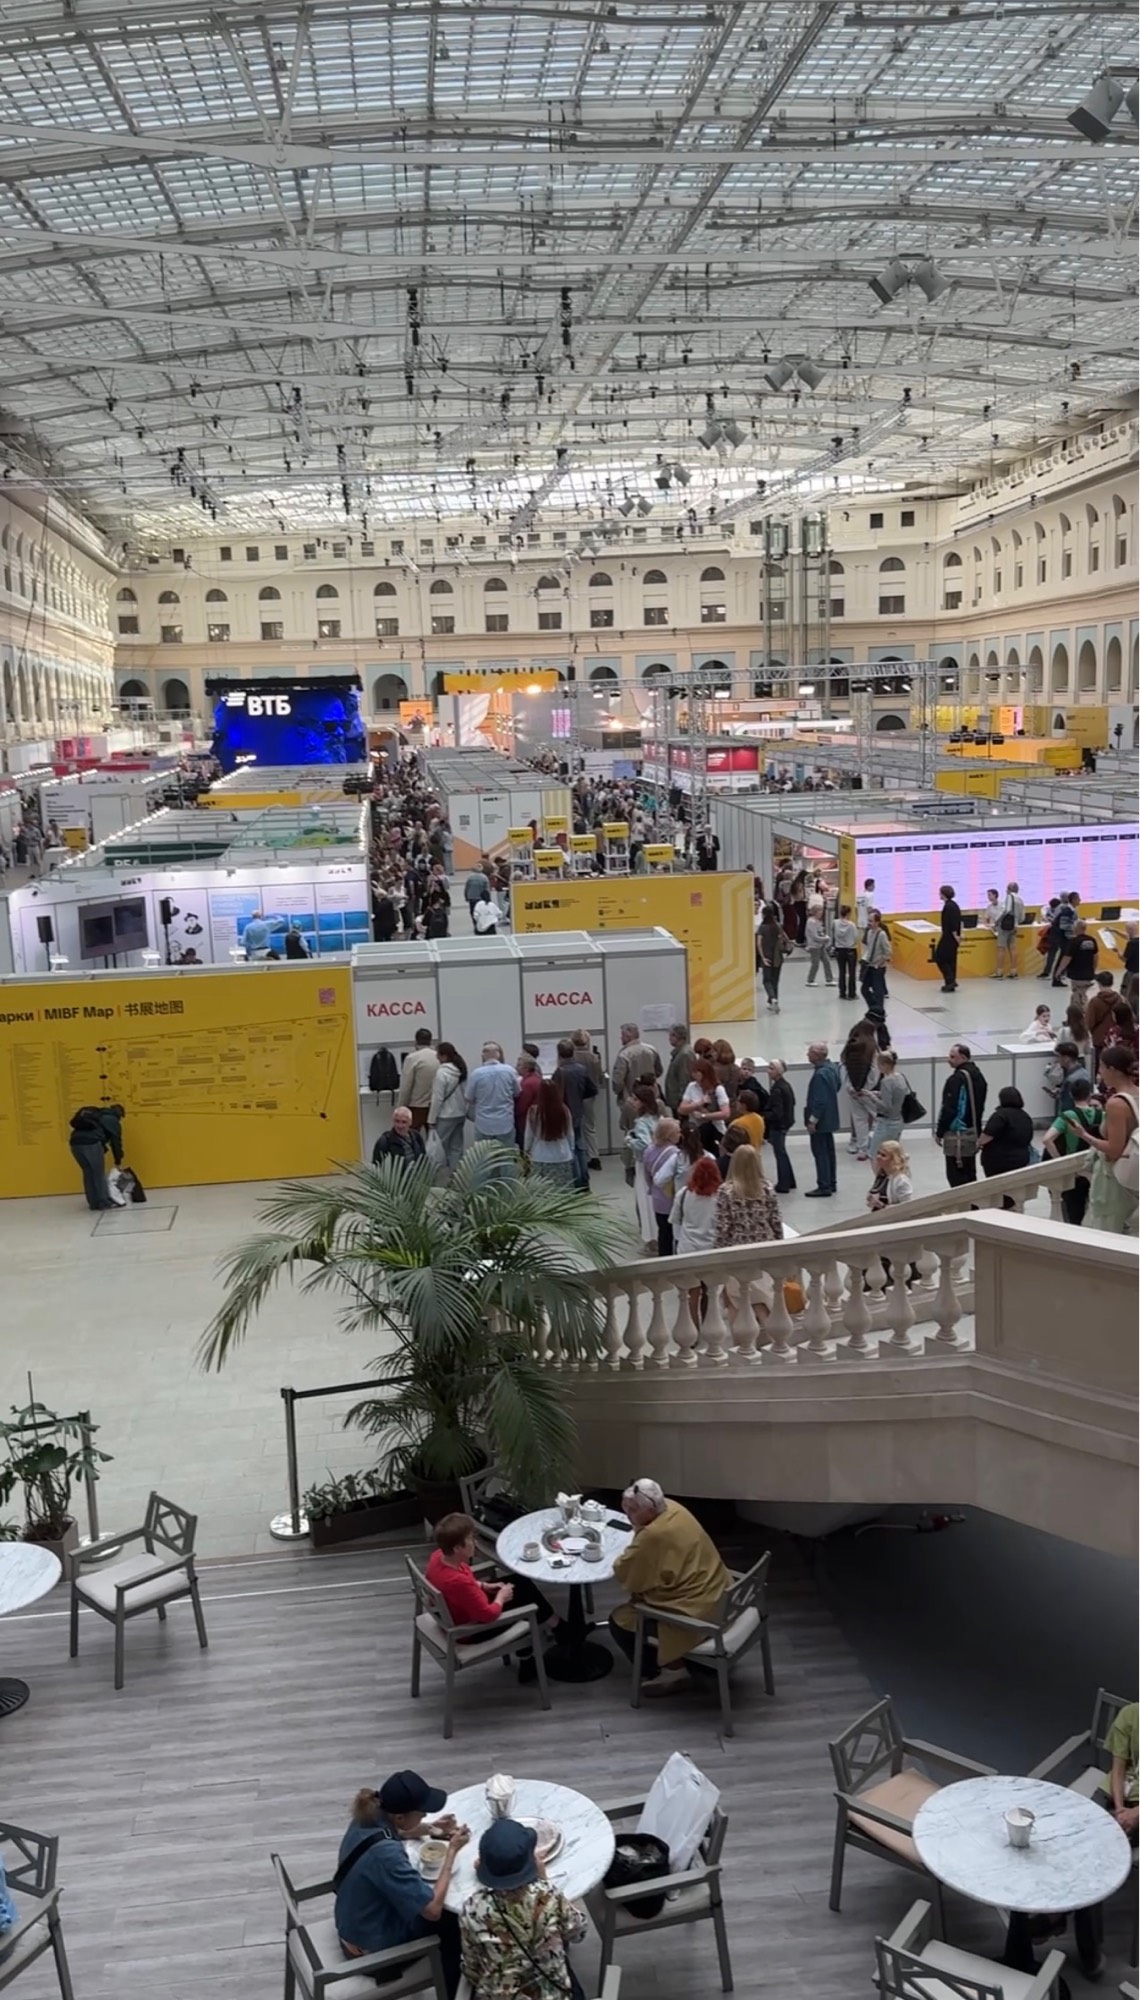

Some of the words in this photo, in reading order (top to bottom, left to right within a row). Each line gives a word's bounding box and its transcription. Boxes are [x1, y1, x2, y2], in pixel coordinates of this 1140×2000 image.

[246, 694, 292, 716] ВТБ
[535, 991, 593, 1007] КАССА
[44, 1007, 79, 1020] MIBF
[83, 1006, 114, 1019] Map
[124, 1000, 184, 1016] 书展地图
[366, 1001, 426, 1017] КАССА
